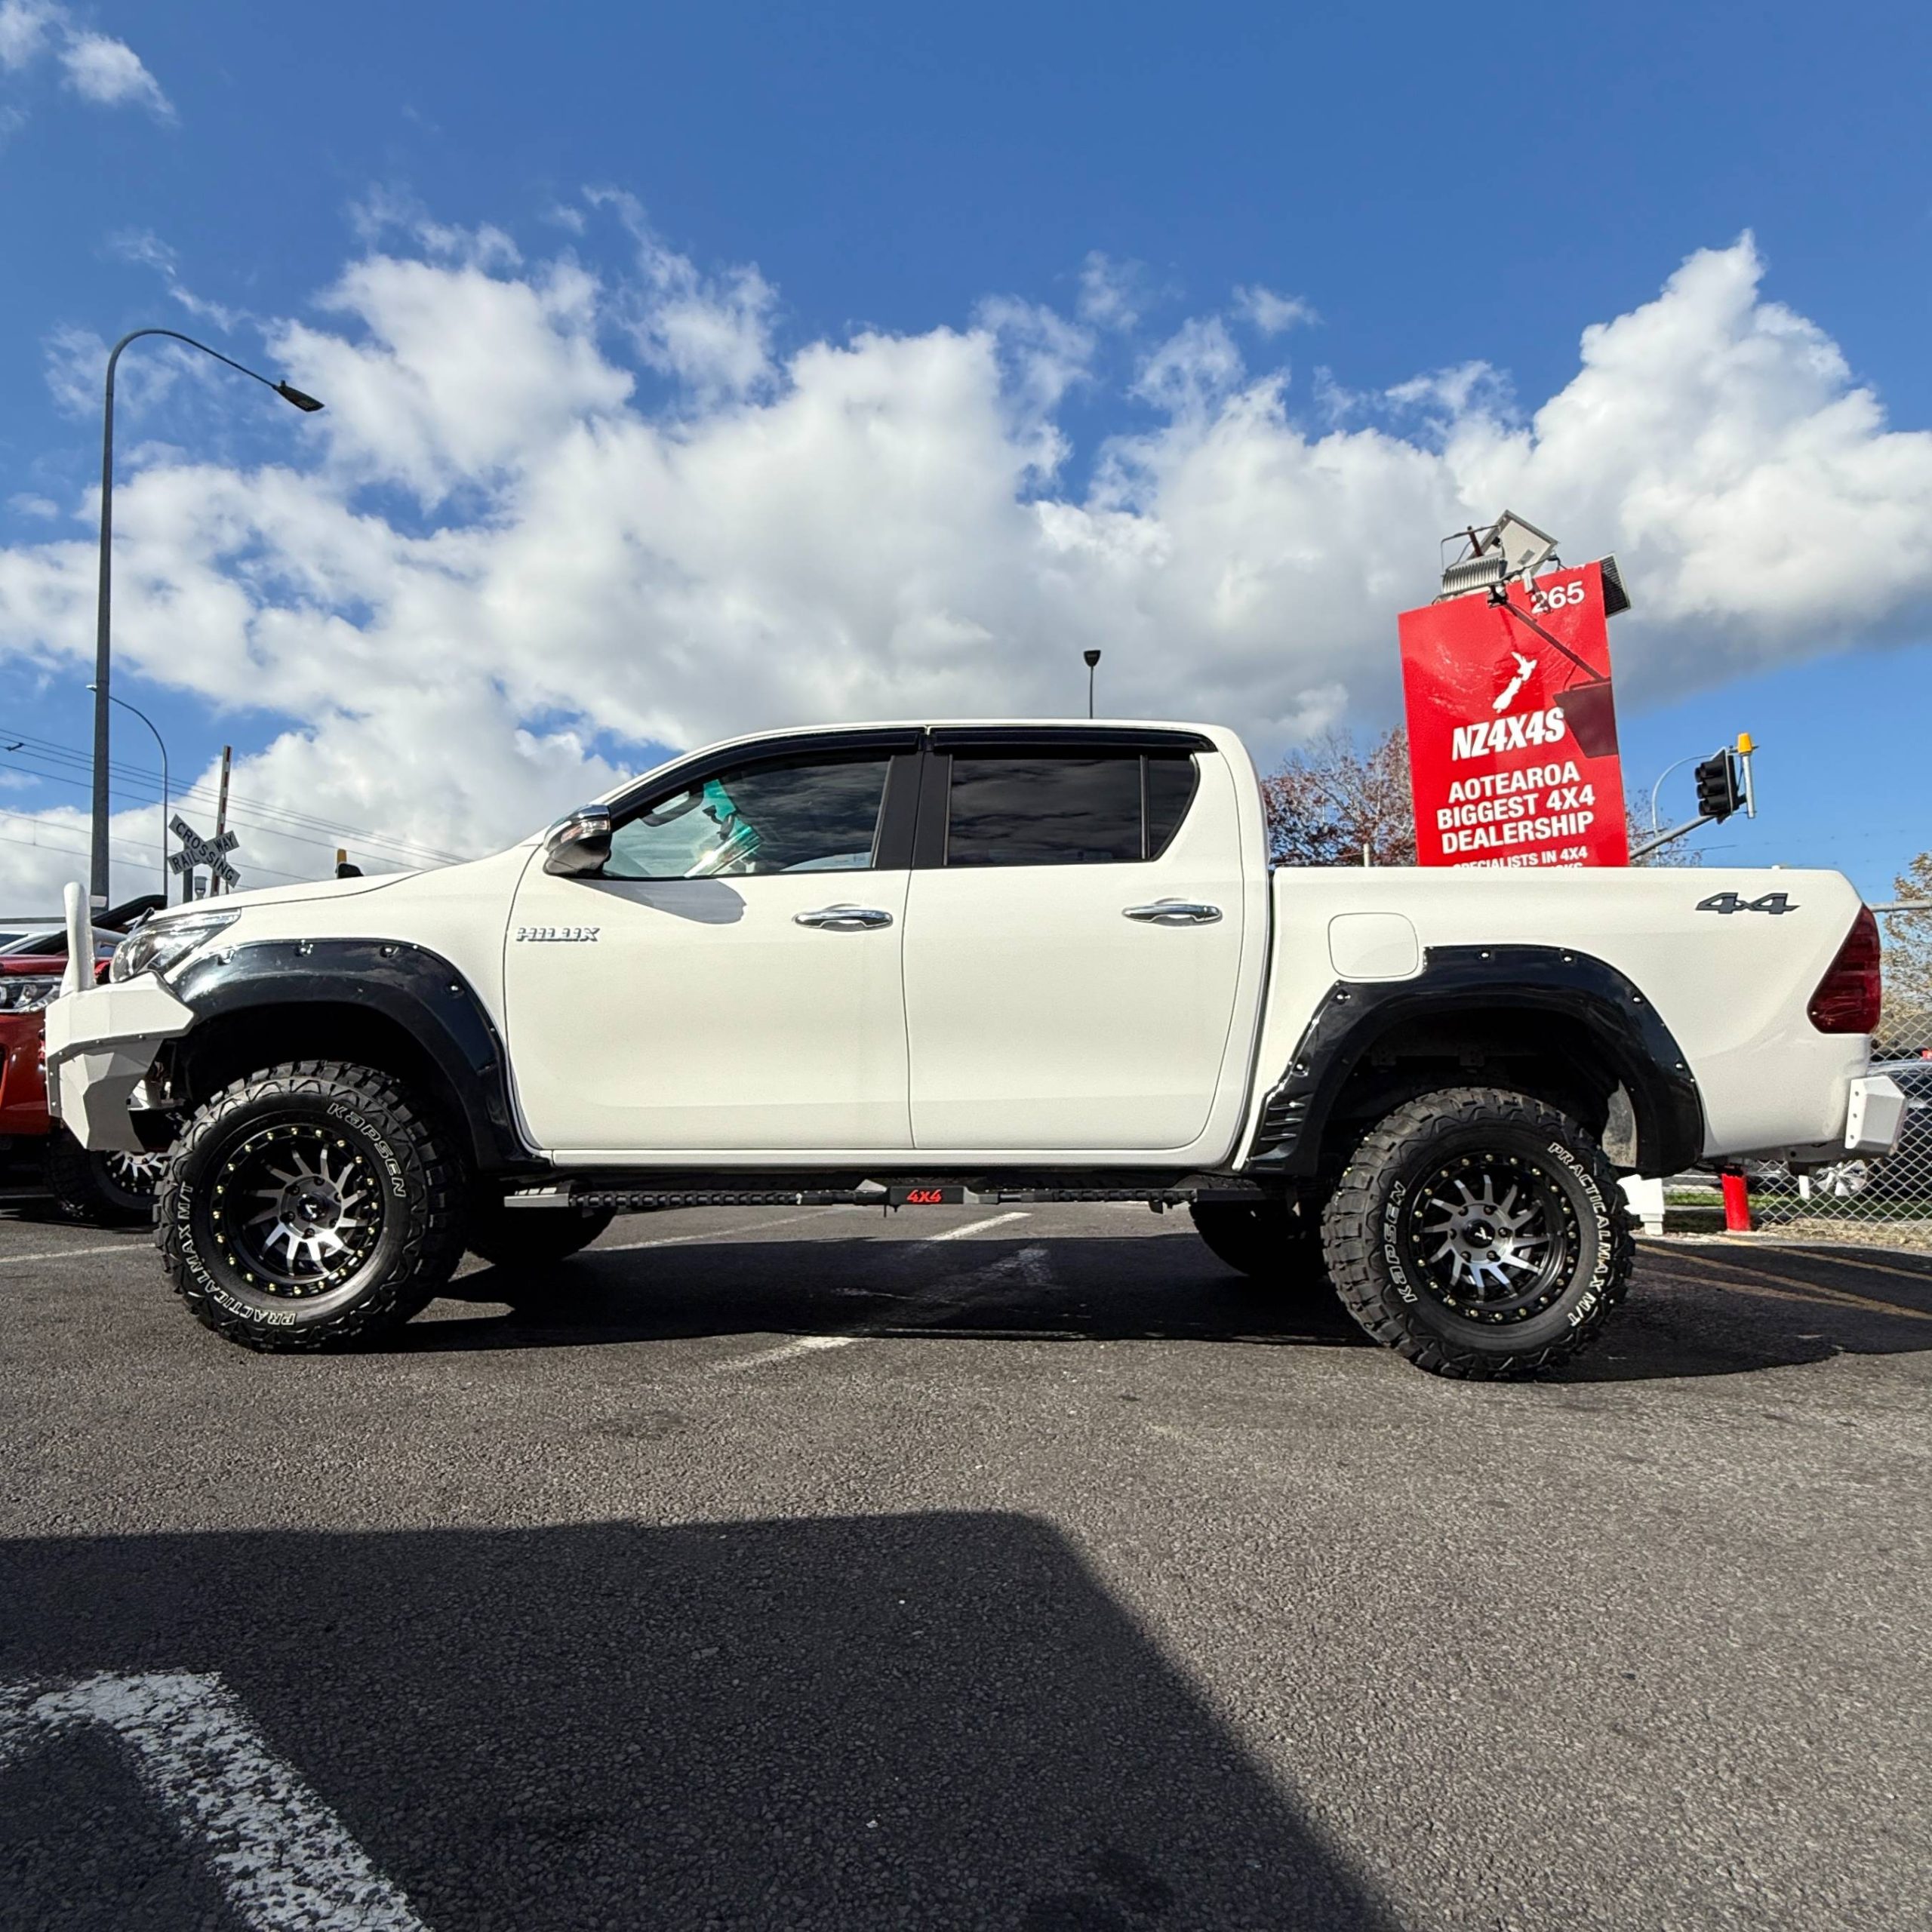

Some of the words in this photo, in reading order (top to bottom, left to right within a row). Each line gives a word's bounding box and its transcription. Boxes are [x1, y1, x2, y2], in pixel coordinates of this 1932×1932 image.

[1531, 580, 1585, 614] 265
[1452, 707, 1565, 761] NZ4X4S
[1448, 761, 1580, 804] AOTEAROA
[1437, 793, 1539, 829] BIGGEST
[1546, 784, 1595, 811] 4X4
[176, 823, 235, 881] CROSSING
[1441, 811, 1594, 854] DEALERSHIP
[172, 850, 200, 871] RAIL
[214, 834, 234, 853] WAY
[1453, 853, 1539, 867] ECIALISTS
[1541, 850, 1558, 863] IN
[1559, 845, 1588, 860] 4X4
[516, 928, 601, 942] HILUX
[177, 1181, 193, 1220] M/T
[1567, 1291, 1597, 1327] M/T
